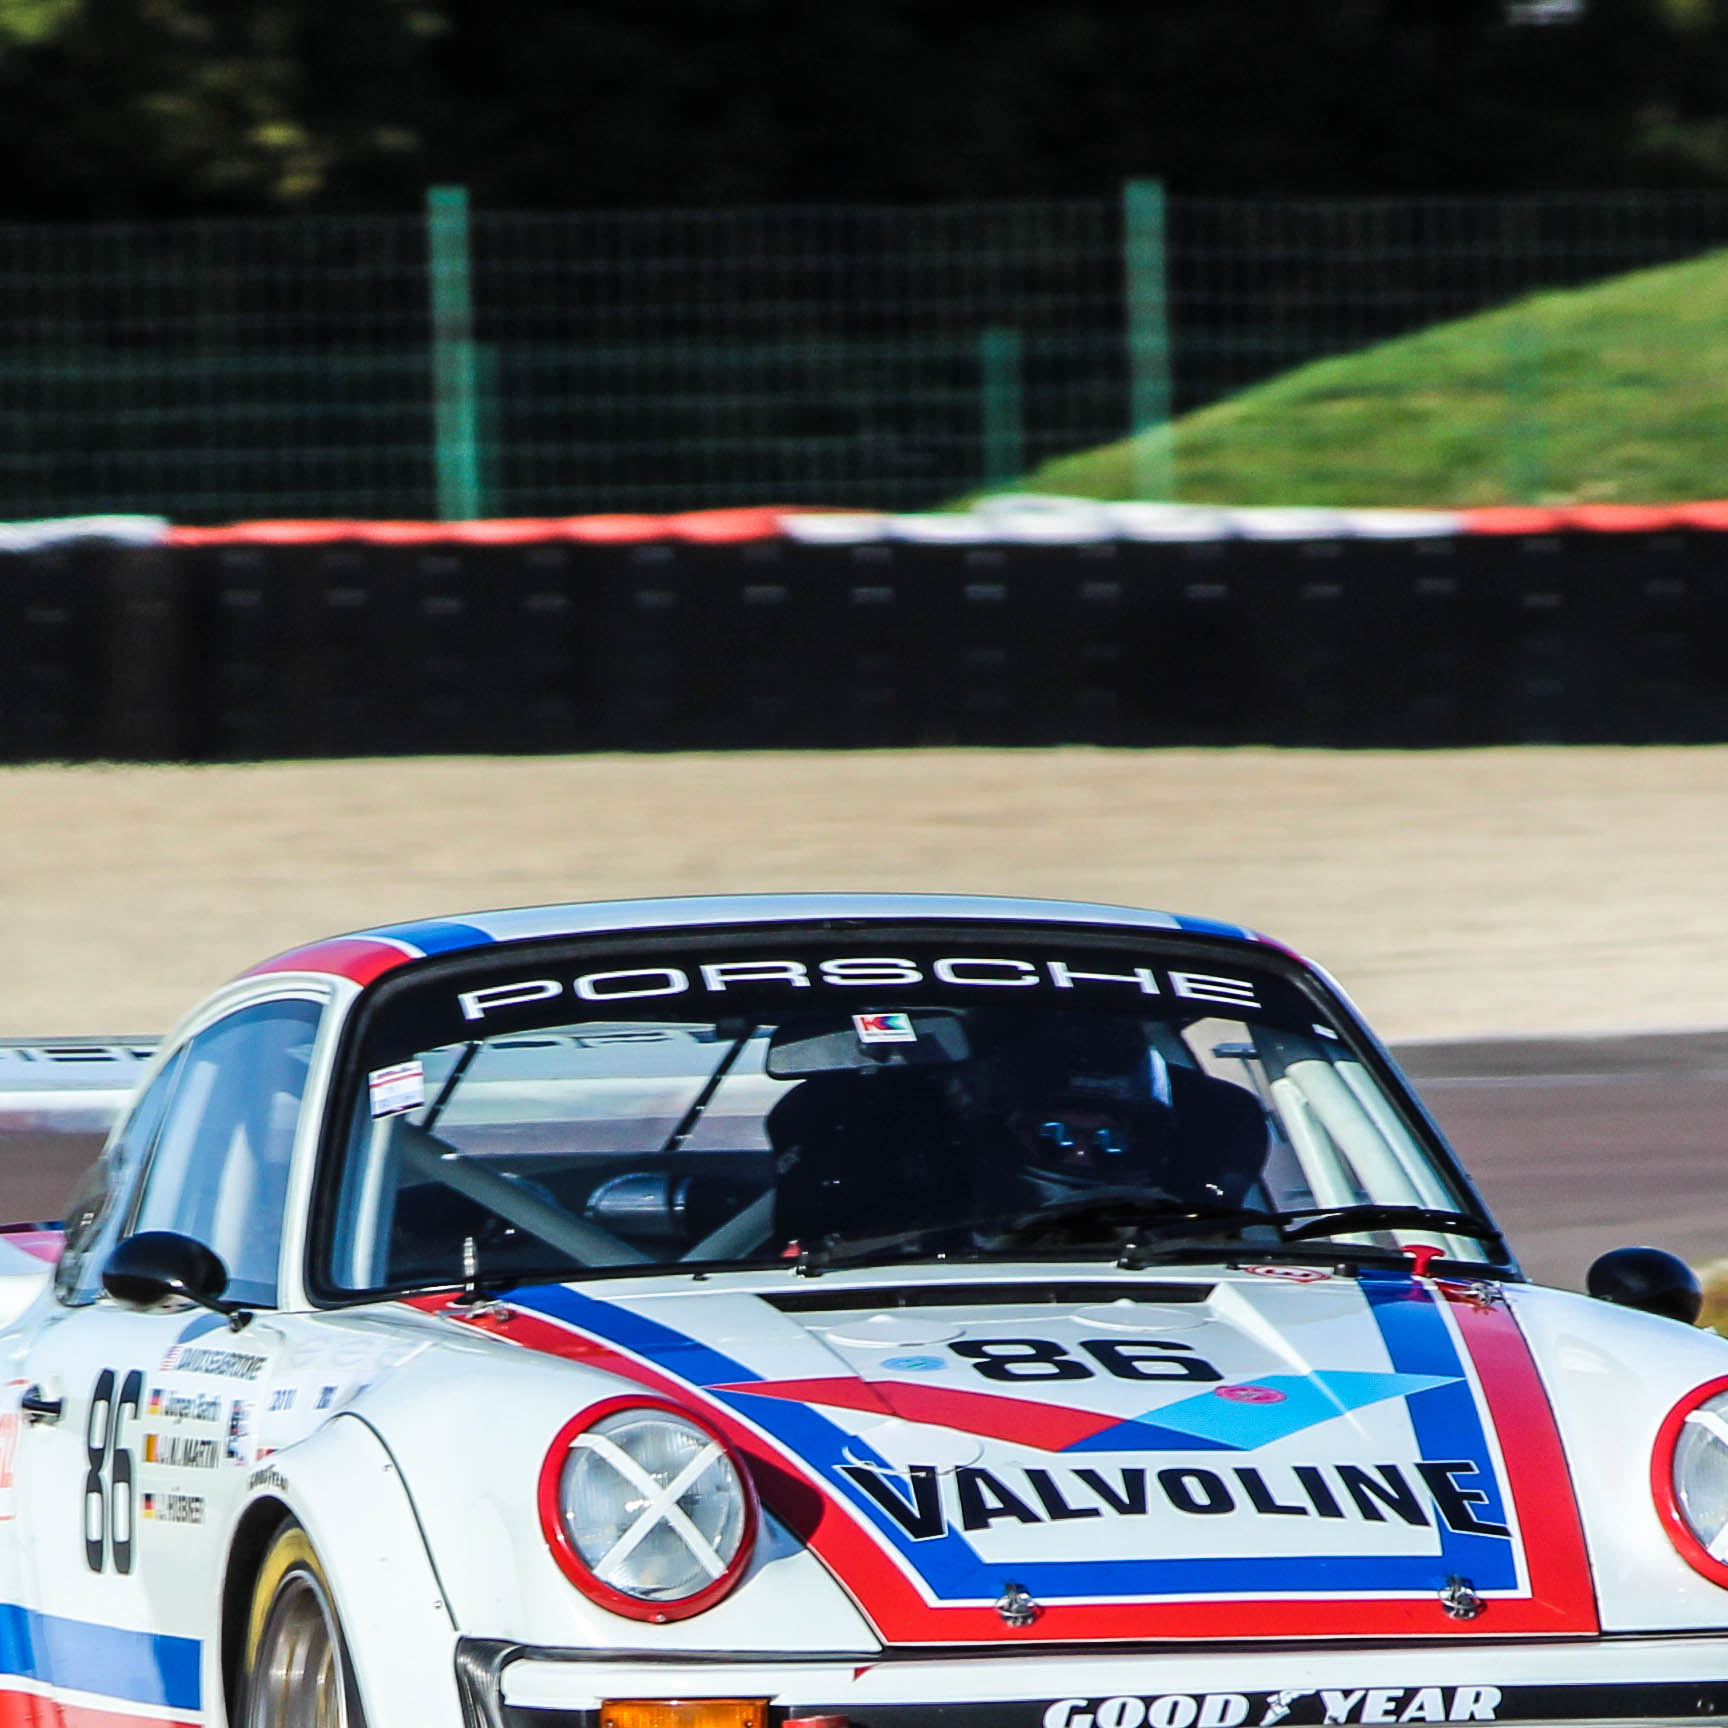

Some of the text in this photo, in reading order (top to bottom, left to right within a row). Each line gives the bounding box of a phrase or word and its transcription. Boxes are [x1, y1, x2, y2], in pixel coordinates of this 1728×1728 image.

[458, 957, 1262, 1019] PORSCHE
[948, 1338, 1224, 1382] 86
[85, 1368, 142, 1574] 86
[834, 1460, 1512, 1541] VALVOLINE
